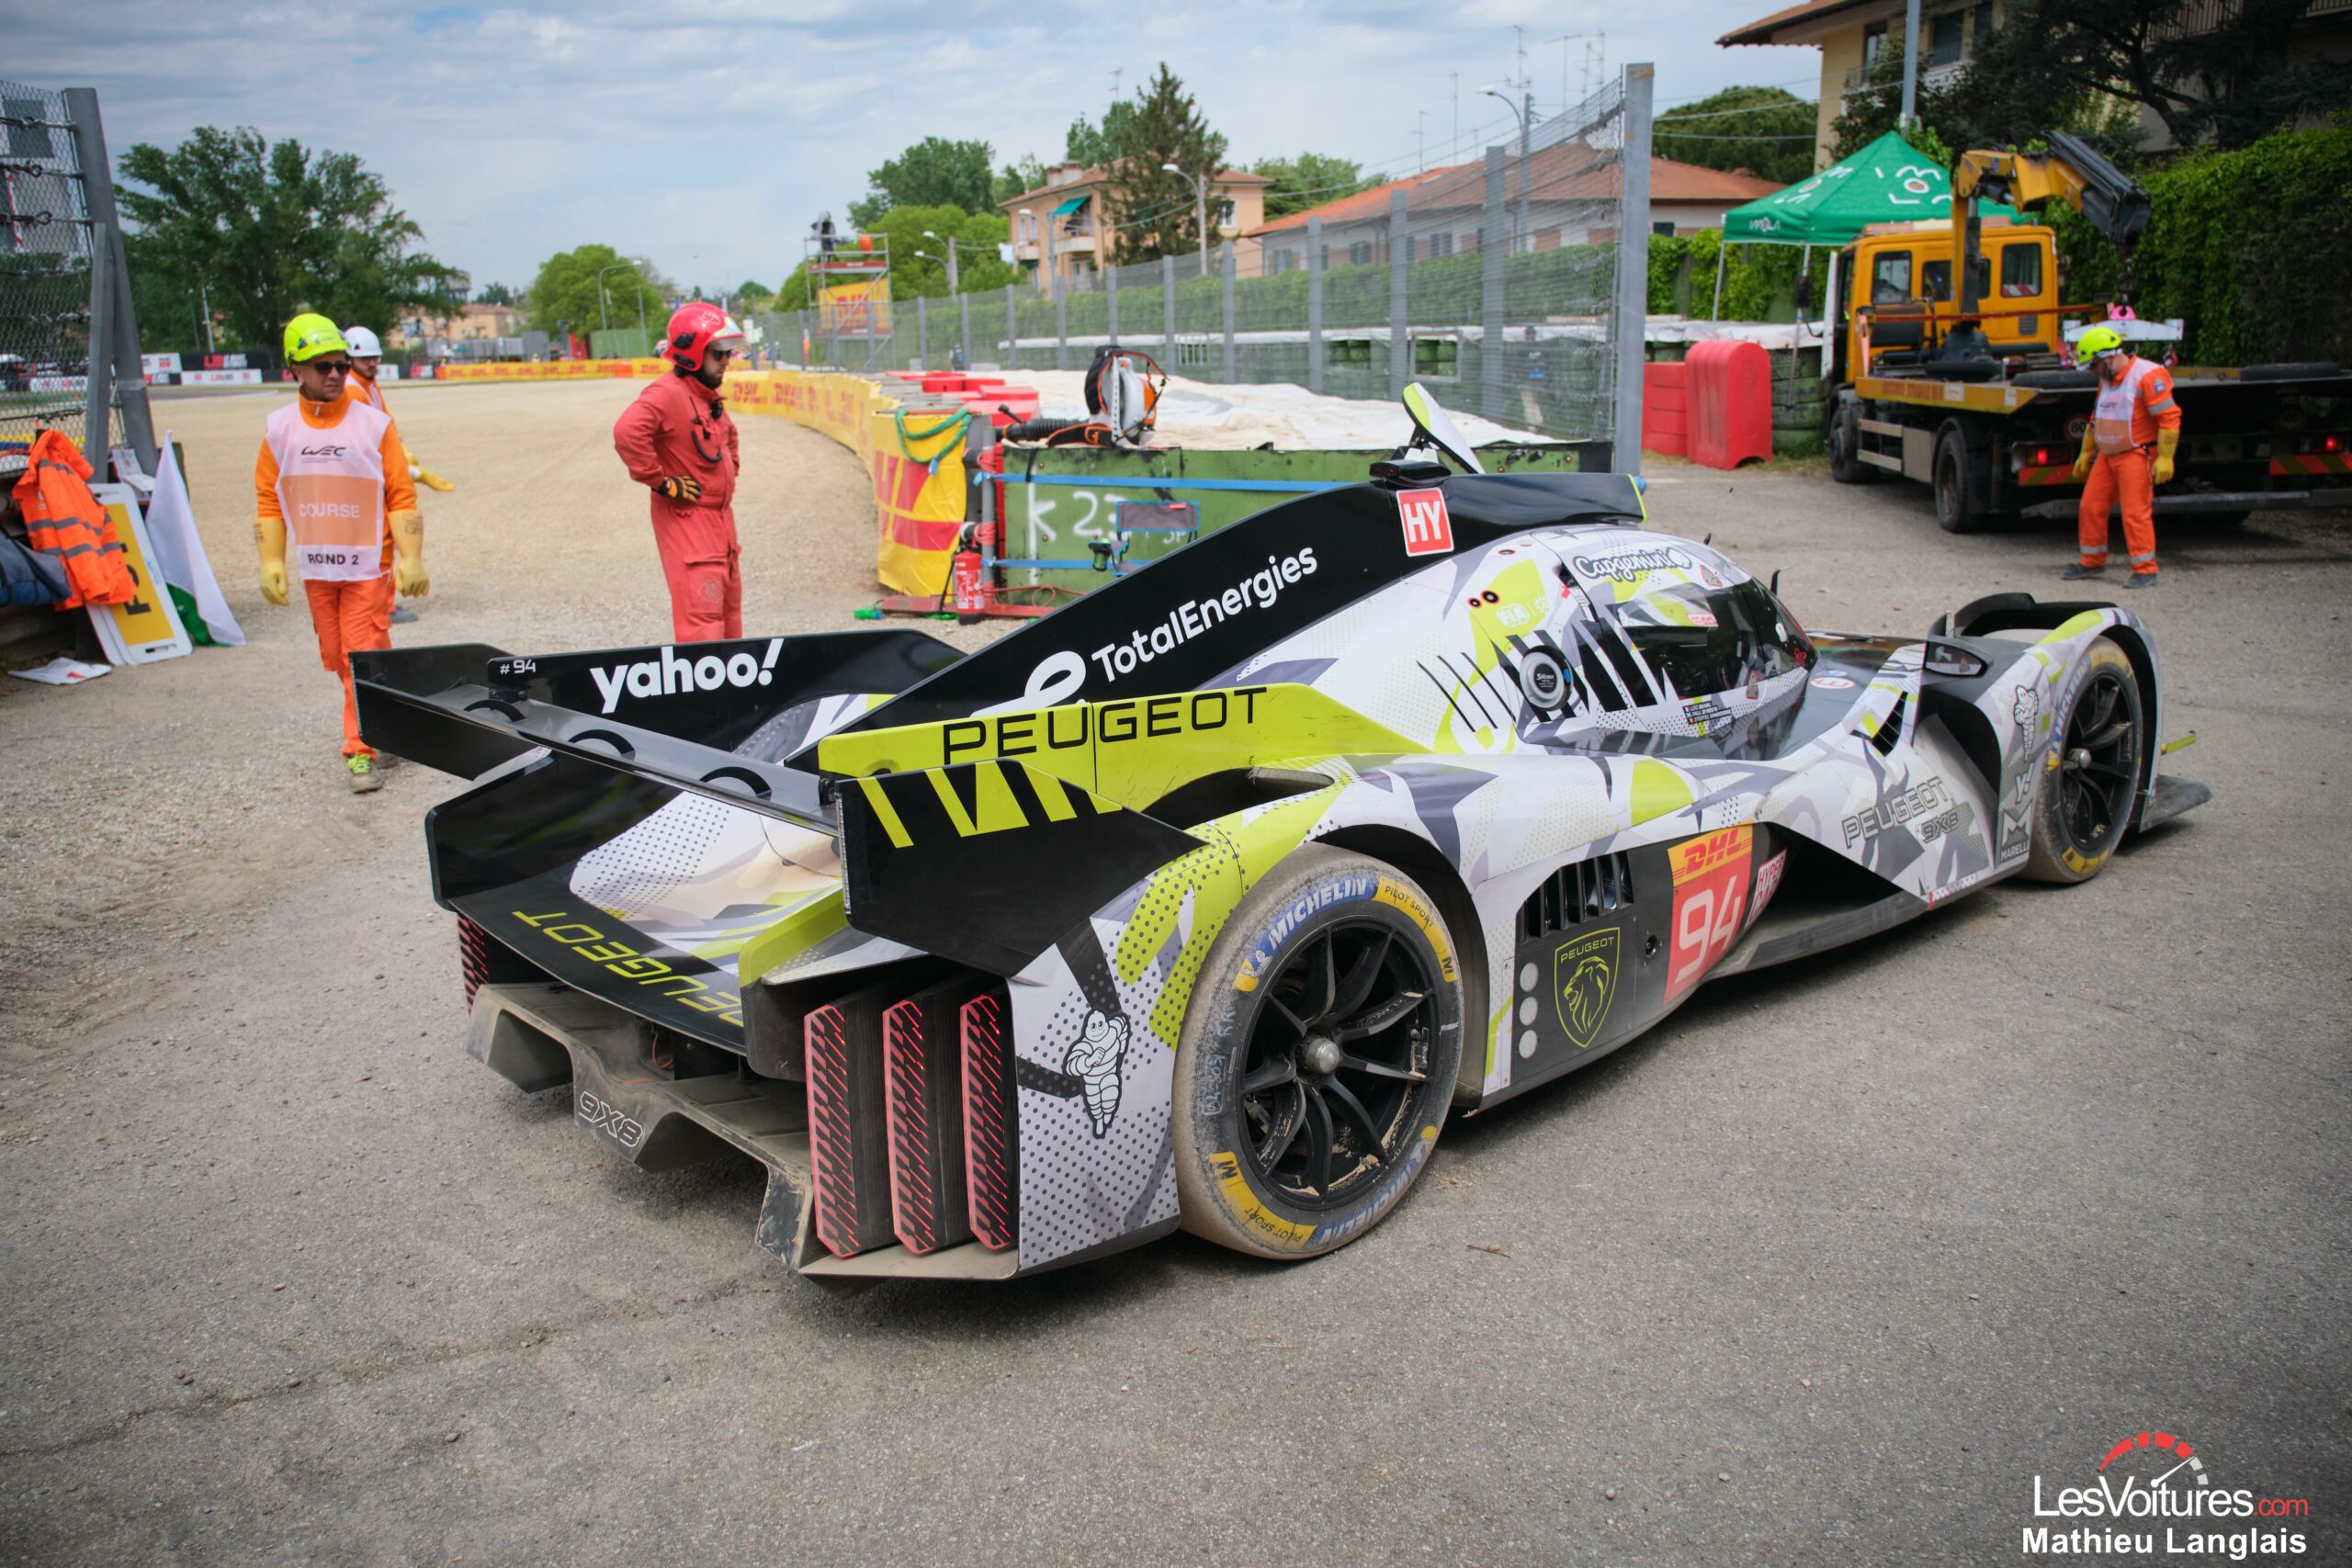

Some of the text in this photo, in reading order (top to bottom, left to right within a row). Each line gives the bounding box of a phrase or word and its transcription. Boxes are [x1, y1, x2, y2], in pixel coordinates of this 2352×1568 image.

[301, 446, 346, 457] WEC
[300, 502, 360, 519] COURSE
[1403, 500, 1442, 543] HY
[308, 554, 359, 566] ROND 2
[1573, 549, 1674, 582] Capgemini
[1091, 547, 1317, 682] TotalEnergies
[590, 637, 785, 714] yahoo!
[943, 686, 1267, 765] PEUGEOT
[1841, 775, 1948, 849] PEUGEOT
[1918, 807, 1960, 843] 9X8
[1685, 828, 1739, 874] DHL
[2000, 844, 2030, 862] MARELLI
[1267, 877, 1367, 951] MICHELIN
[1385, 885, 1434, 928] PILOT SPORT
[1674, 874, 1742, 985] 94
[1441, 955, 1454, 975] M
[1560, 936, 1615, 964] PEUGEOT
[580, 1090, 644, 1147] 9X8
[1216, 1159, 1238, 1180] M
[1244, 1206, 1304, 1243] PILOT SPORT
